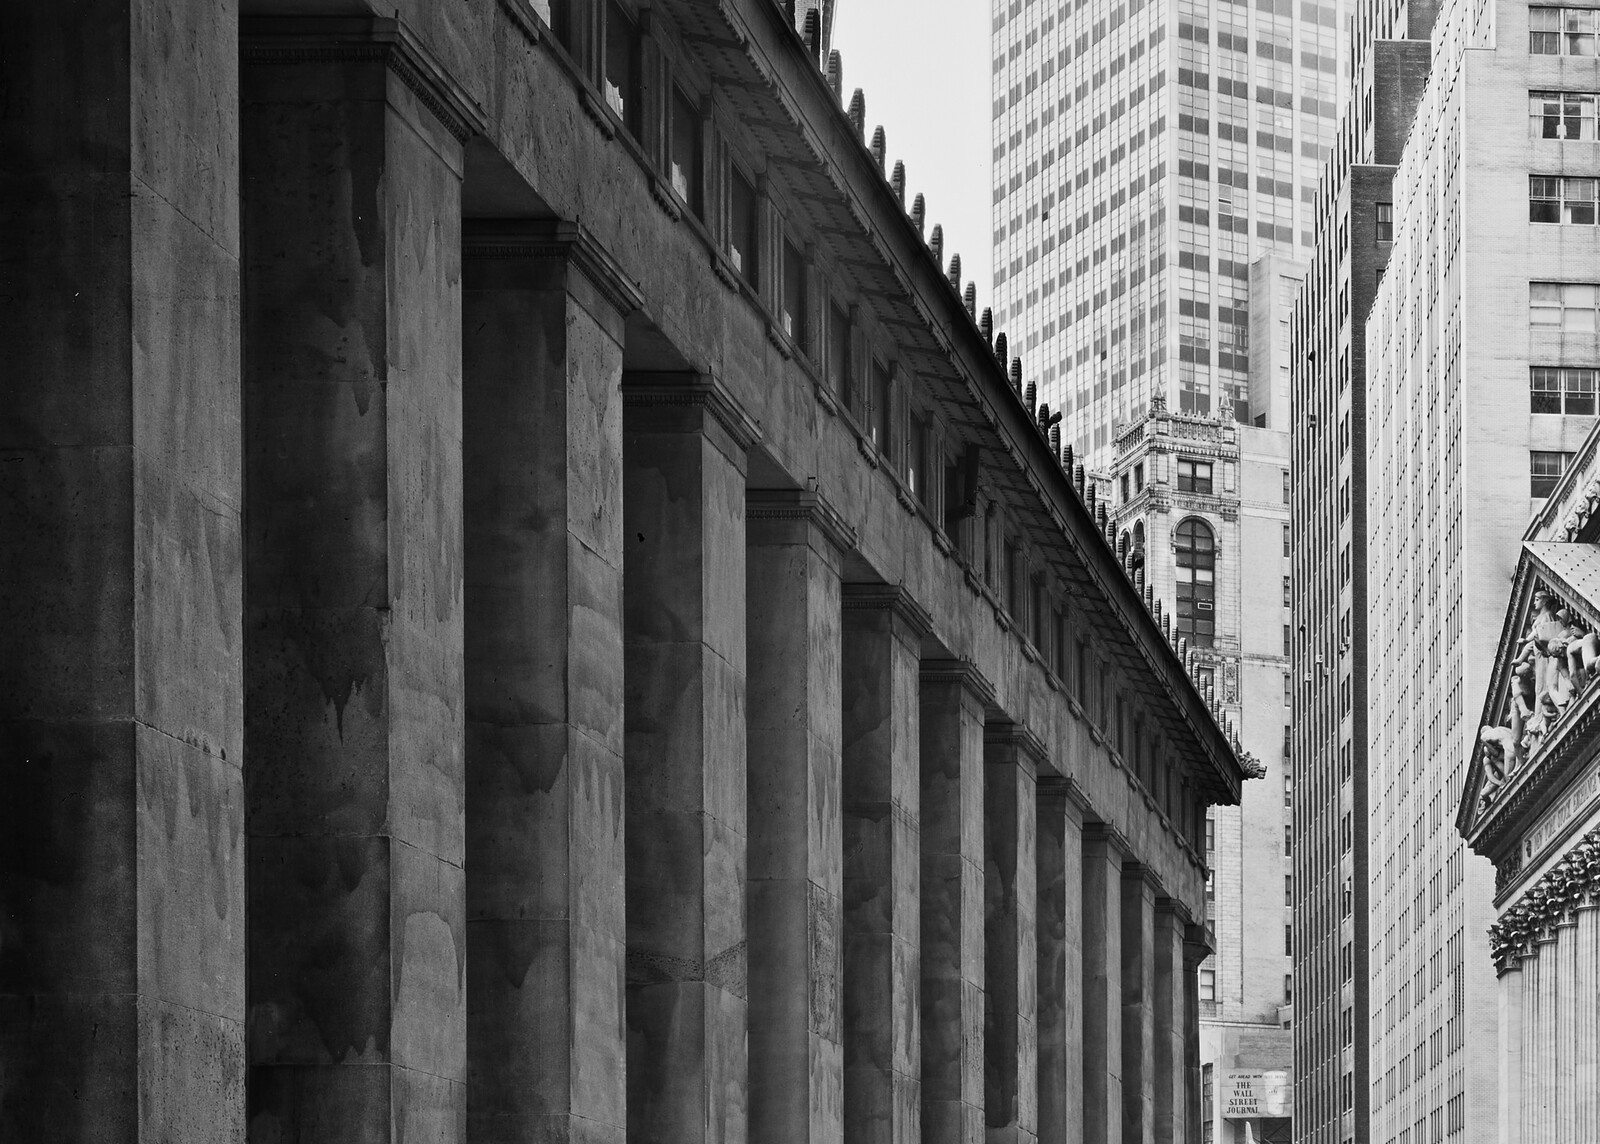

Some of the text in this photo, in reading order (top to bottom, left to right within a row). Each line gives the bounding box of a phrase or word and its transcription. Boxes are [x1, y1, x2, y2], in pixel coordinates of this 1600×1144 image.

[1236, 1081, 1251, 1089] THE
[1229, 1098, 1258, 1106] STREET
[1226, 1106, 1260, 1114] JOURNAL
